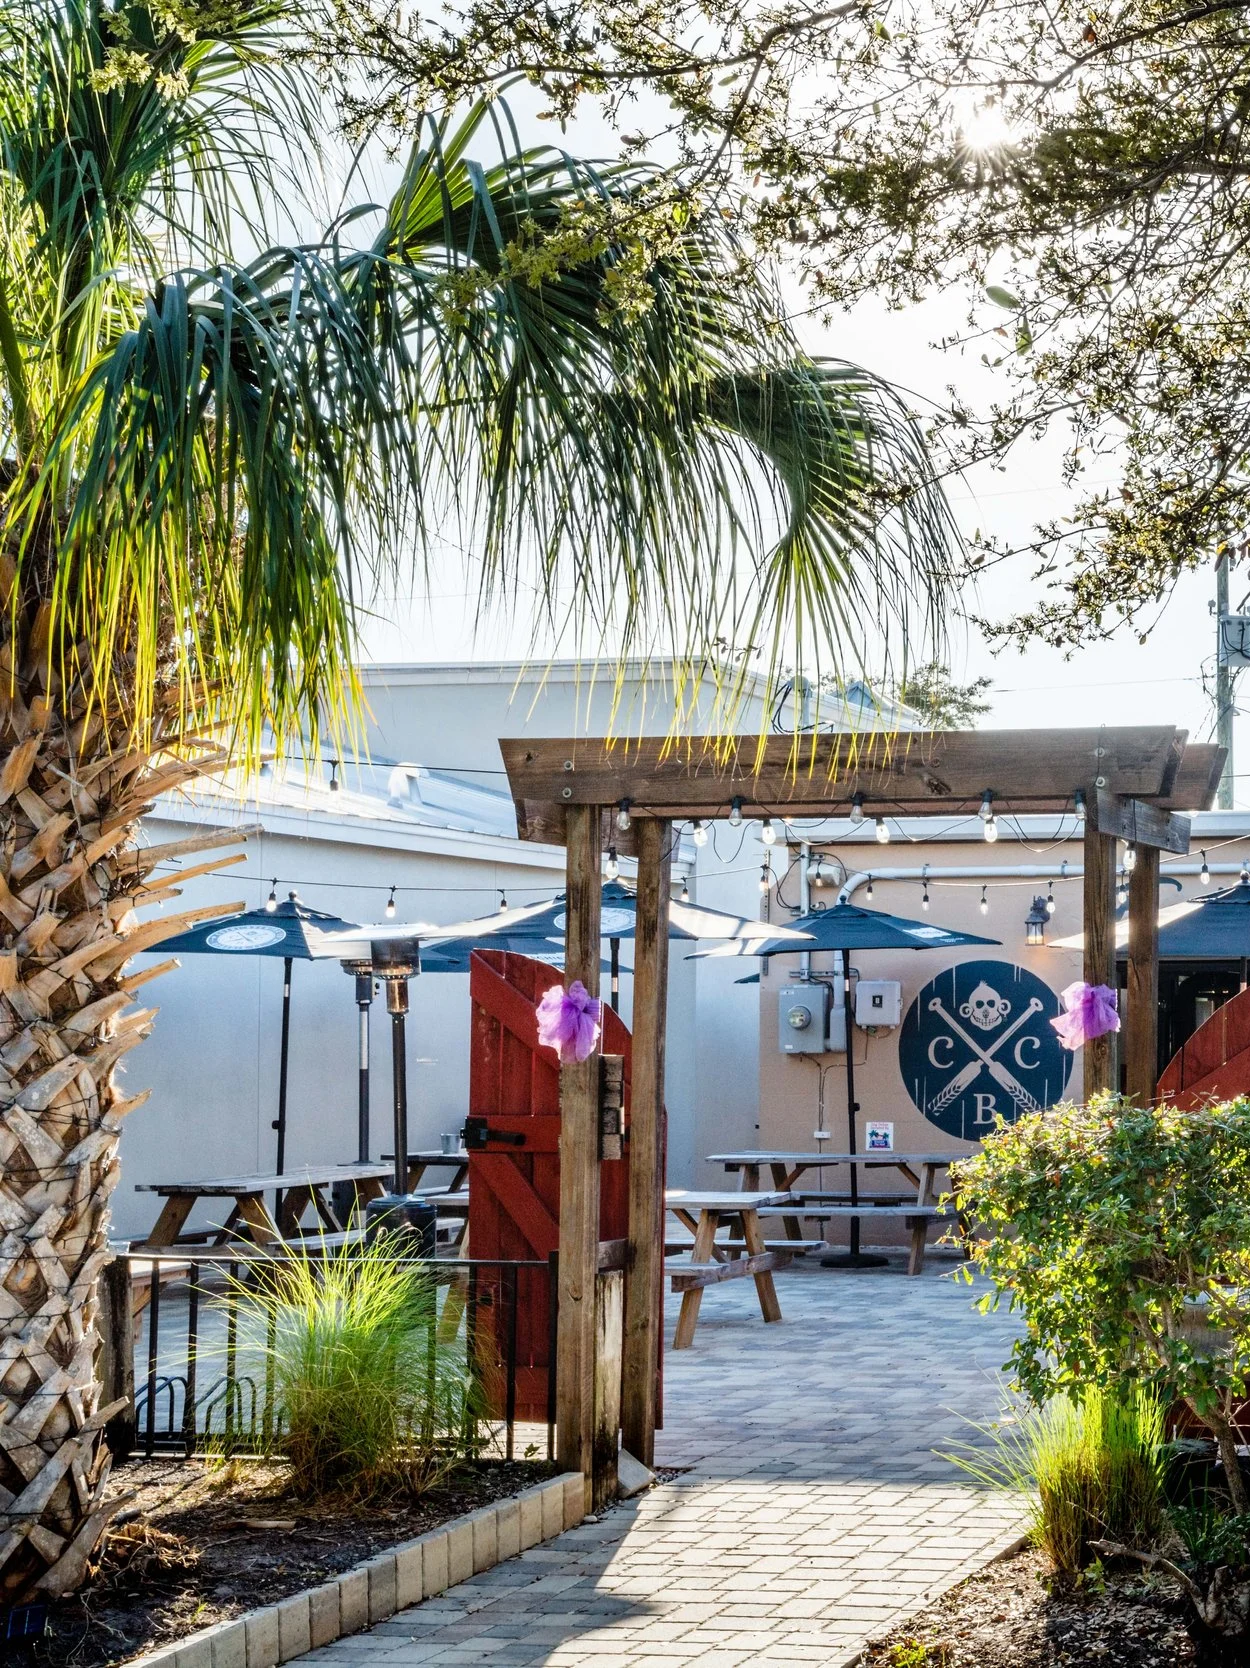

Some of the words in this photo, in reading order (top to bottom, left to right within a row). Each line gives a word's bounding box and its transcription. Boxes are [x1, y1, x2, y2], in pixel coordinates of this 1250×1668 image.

[928, 1036, 954, 1069] C
[1014, 1036, 1041, 1069] C
[973, 1093, 998, 1125] B
